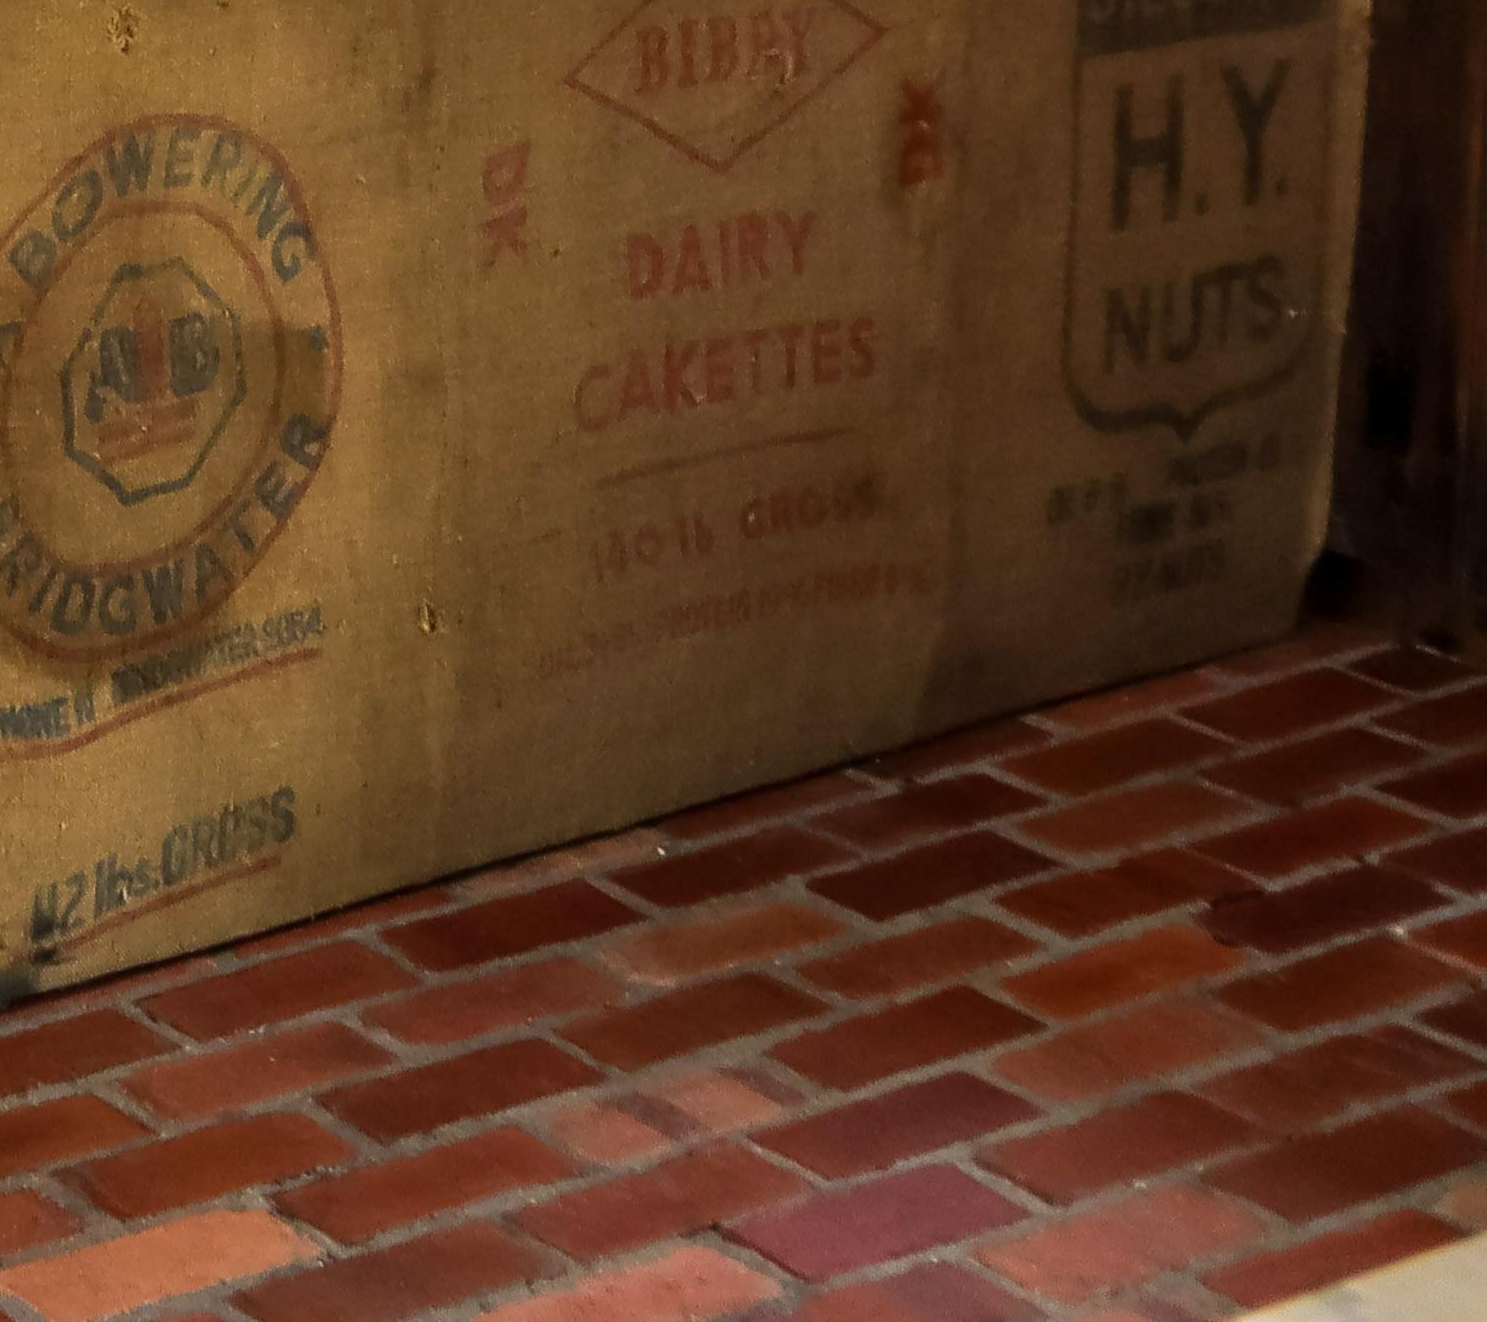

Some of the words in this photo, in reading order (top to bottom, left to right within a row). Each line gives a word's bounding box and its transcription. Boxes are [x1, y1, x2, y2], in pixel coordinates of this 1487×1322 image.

[8, 125, 316, 288] BOWERING
[626, 210, 817, 300] DAIRY
[1105, 256, 1285, 374] NUTS
[574, 316, 879, 433] CAKETTES
